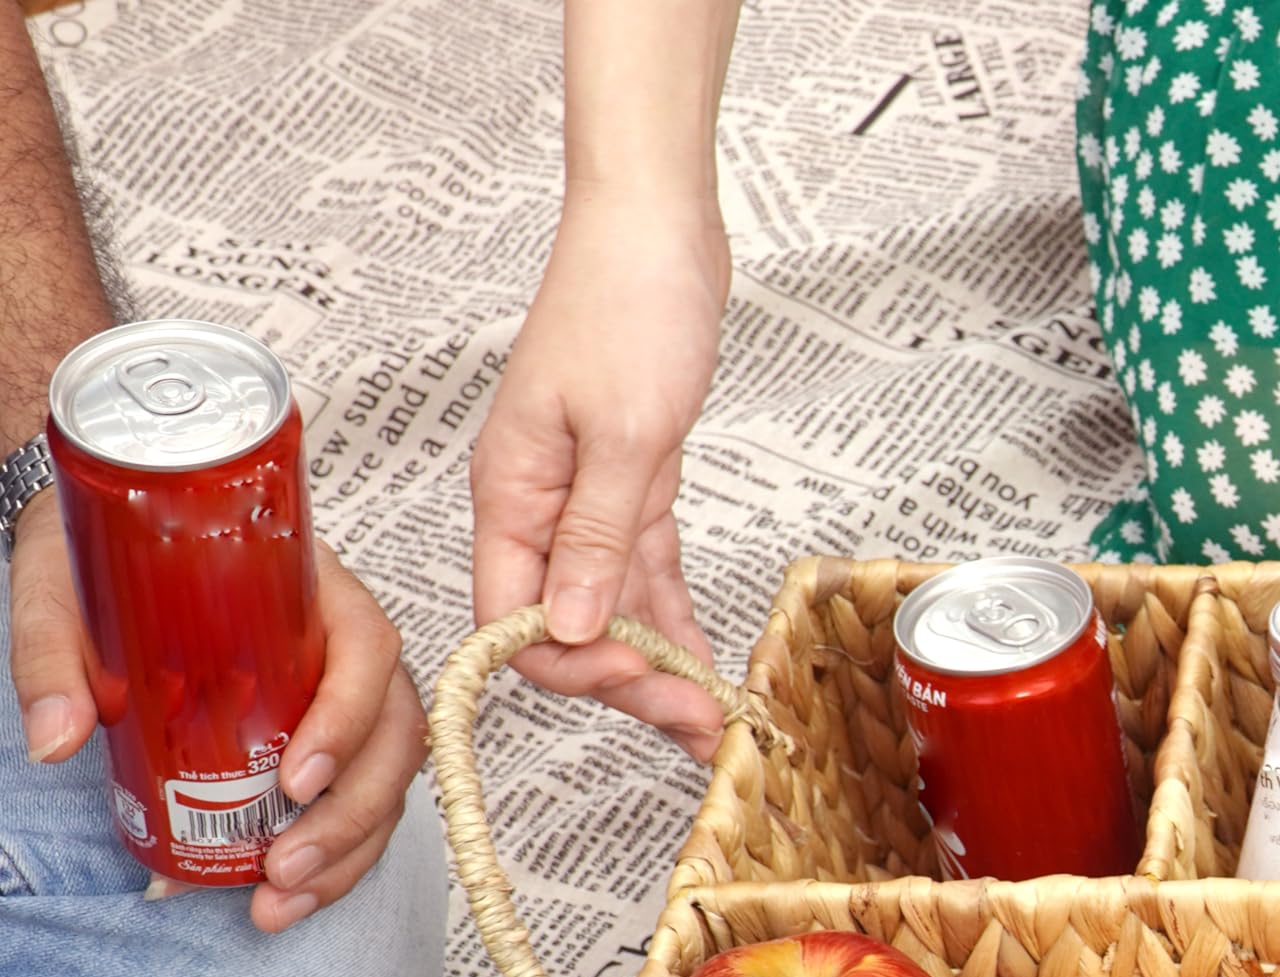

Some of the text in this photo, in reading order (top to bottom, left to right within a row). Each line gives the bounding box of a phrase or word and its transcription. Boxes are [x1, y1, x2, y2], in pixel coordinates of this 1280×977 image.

[932, 31, 991, 123] LARGE
[377, 383, 429, 447] and
[420, 437, 447, 458] a
[921, 471, 1063, 540] firefighter
[979, 471, 1039, 511] you
[898, 496, 978, 545] with a
[247, 752, 280, 775] 320
